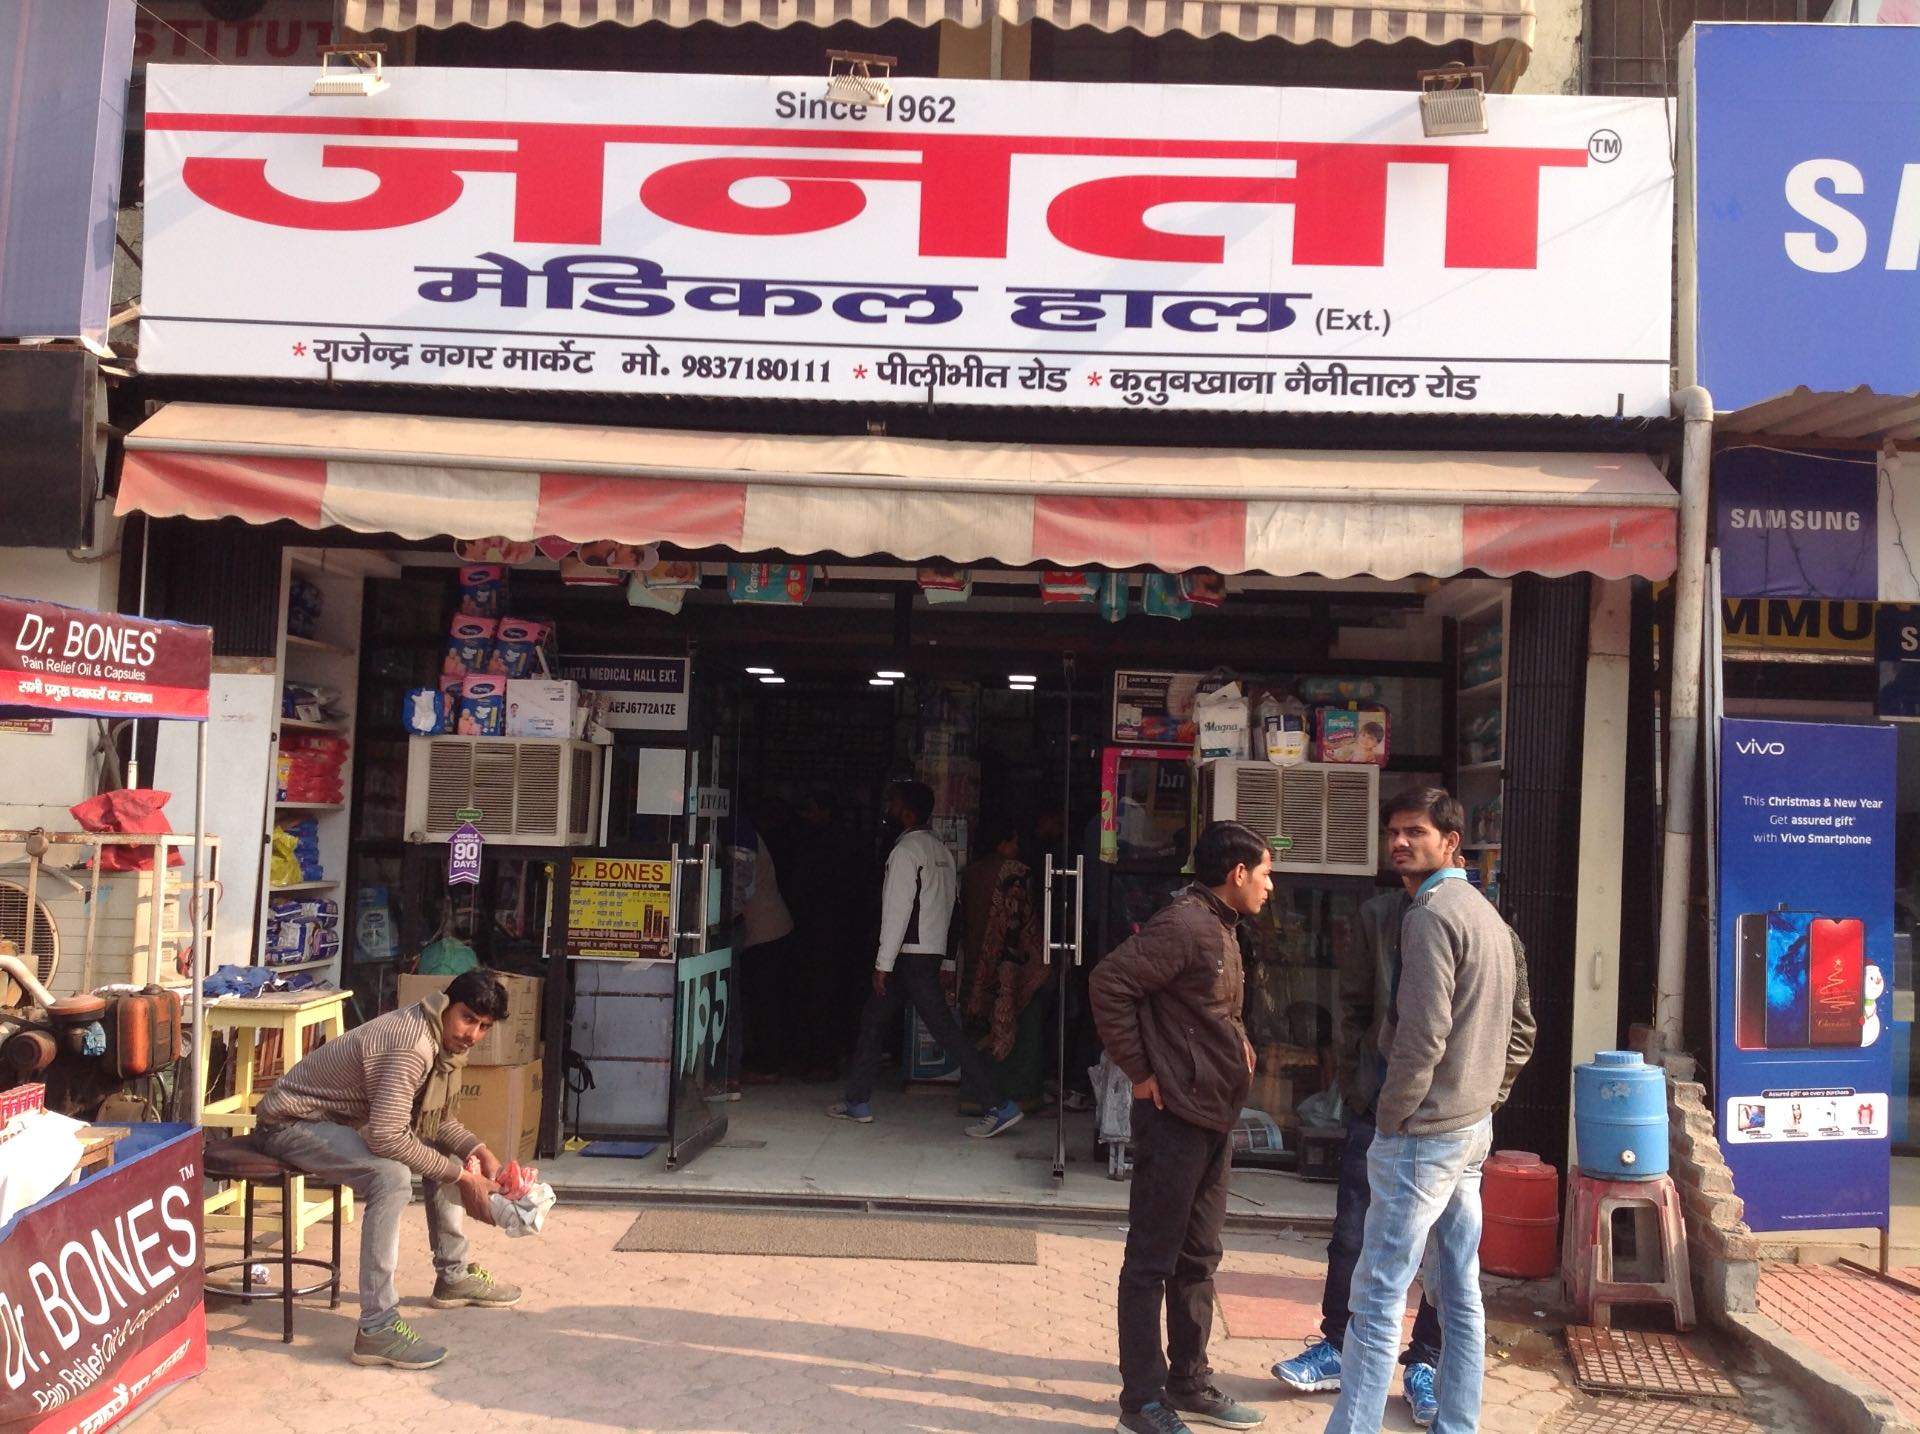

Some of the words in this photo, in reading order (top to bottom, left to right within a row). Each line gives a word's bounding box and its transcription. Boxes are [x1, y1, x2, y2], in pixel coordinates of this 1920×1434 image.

[775, 91, 868, 122] Since
[885, 95, 956, 123] 1962
[146, 112, 1588, 270] जनता
[414, 252, 978, 325] मेडिकल
[1006, 286, 1313, 332] हाल
[1315, 308, 1392, 337] (Ext.)
[313, 332, 413, 370] राजेन्द्र
[420, 344, 496, 370] नगर
[503, 340, 594, 374] मार्केट
[621, 344, 671, 376] मो.
[681, 355, 830, 383] 9837180111
[876, 352, 1010, 389] पीलीभीत
[1018, 358, 1071, 393] रोड
[1110, 368, 1277, 406] कुतुबखाना
[1285, 361, 1419, 399] नैनीताल
[1426, 365, 1480, 401] रोड
[1731, 508, 1860, 531] SAMSUNG
[15, 613, 55, 654] Dr.
[63, 621, 157, 666] BONES
[21, 655, 43, 670] Pain
[46, 658, 76, 674] Relief
[77, 663, 91, 676] Oil
[93, 665, 102, 676] &
[104, 666, 146, 682] Capsules
[589, 667, 631, 681] MEDICAL
[633, 669, 656, 682] HALL
[658, 669, 678, 683] EXT.
[1204, 722, 1239, 734] Magna
[1736, 738, 1785, 755] vivo
[1742, 795, 1765, 806] This
[1768, 796, 1821, 807] Christmas
[1823, 798, 1831, 807] &
[1833, 798, 1857, 808] New
[1860, 799, 1883, 809] Year
[1769, 814, 1788, 825] Get
[1791, 816, 1833, 826] assured
[454, 843, 478, 860] 90
[1754, 833, 1777, 843] with
[1780, 834, 1806, 843] Vivo
[1808, 834, 1872, 845] Smartphone
[453, 860, 478, 868] DAYS
[595, 862, 664, 882] BONES
[179, 1163, 194, 1181] TM
[28, 1185, 197, 1351] BONES
[32, 1381, 70, 1414] Pain
[59, 1342, 106, 1396] Relief
